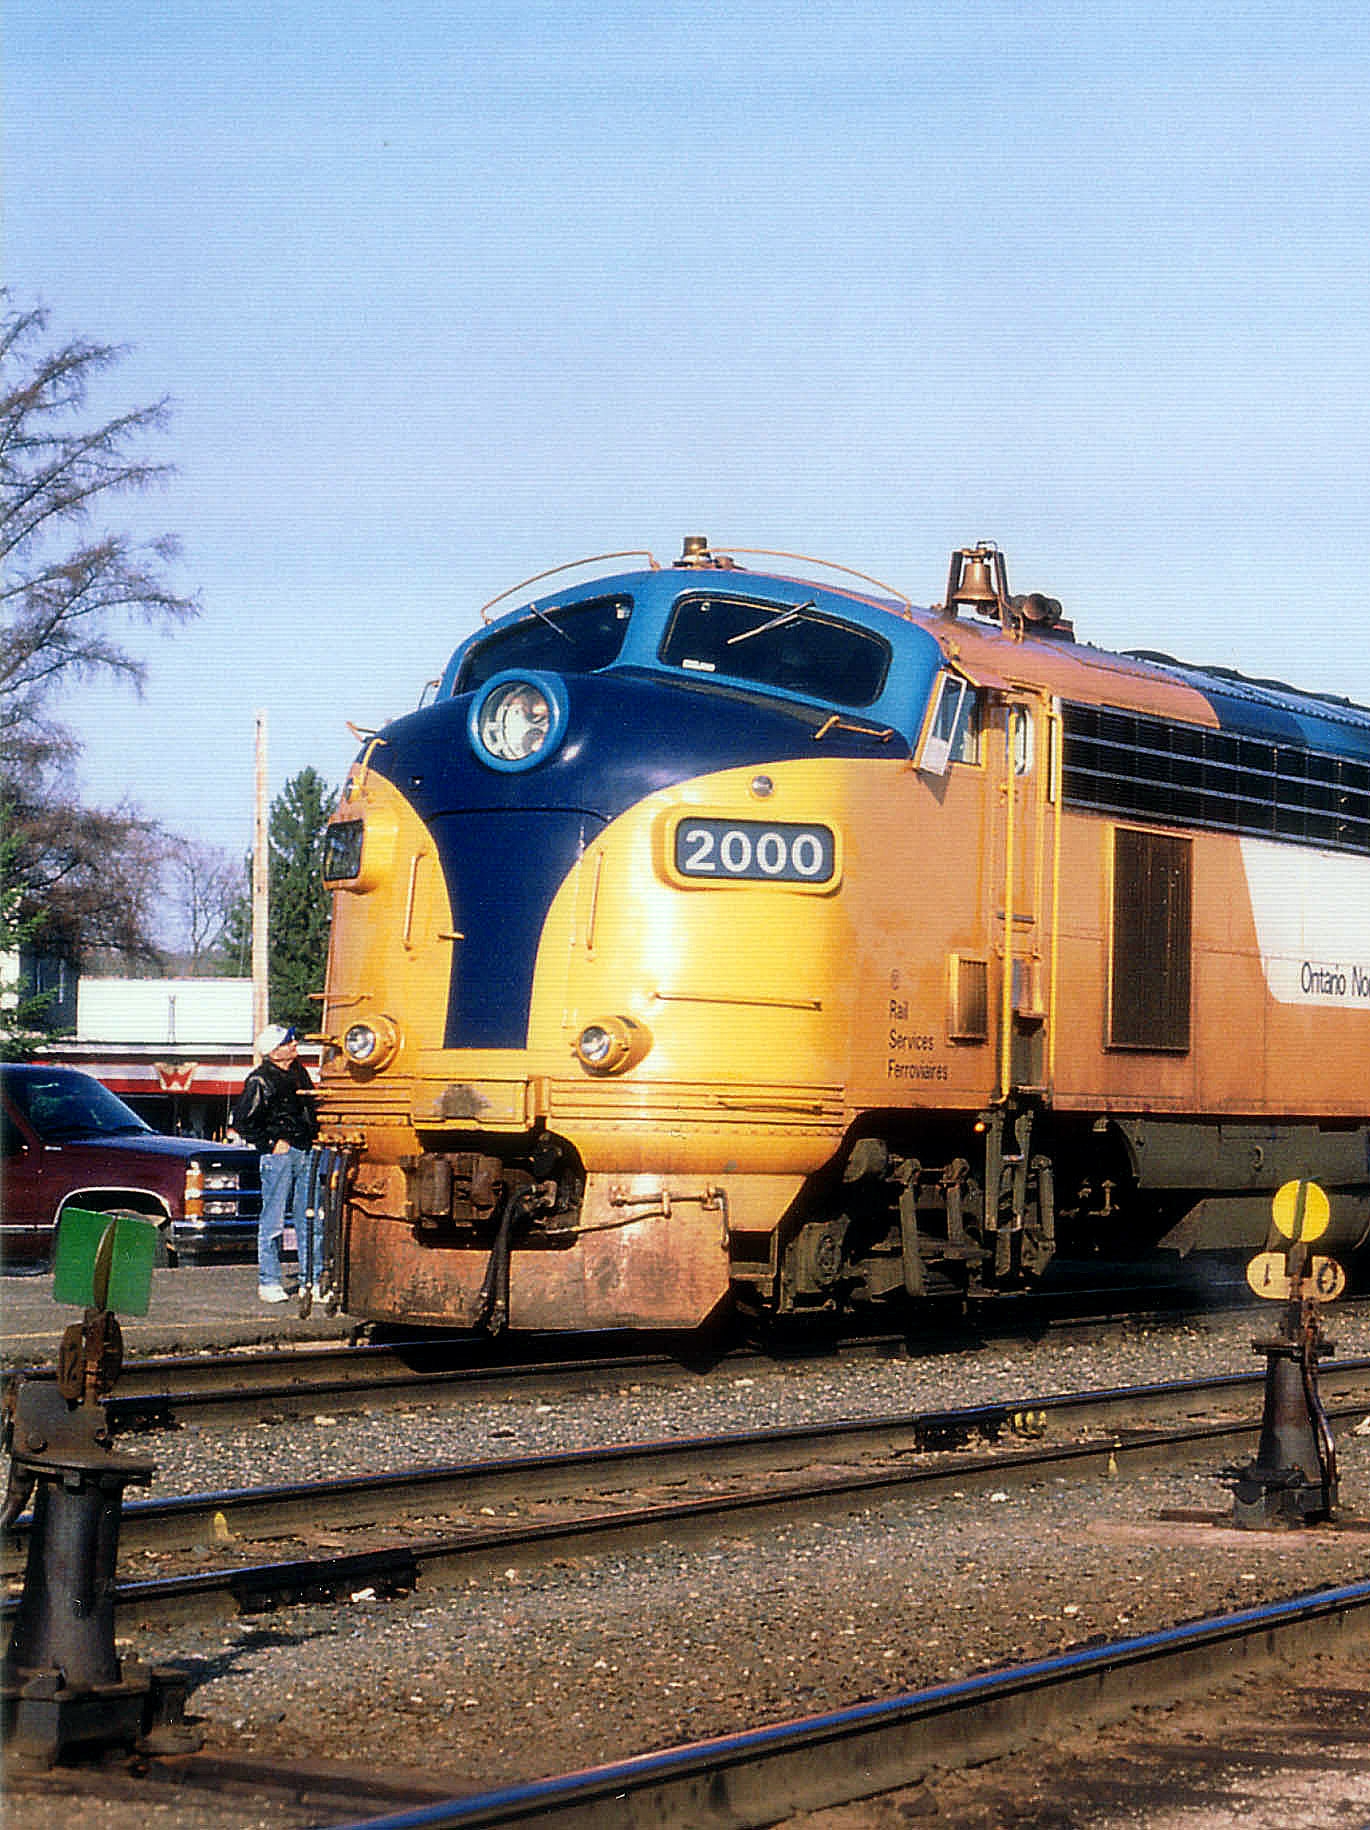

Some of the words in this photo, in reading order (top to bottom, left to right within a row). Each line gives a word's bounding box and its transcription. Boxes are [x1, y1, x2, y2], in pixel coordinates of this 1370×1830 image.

[685, 829, 824, 876] 2000
[1301, 961, 1347, 996] Ontario
[889, 999, 909, 1020] Rail
[888, 1028, 934, 1051] Services
[887, 1058, 949, 1081] Ferroviaires
